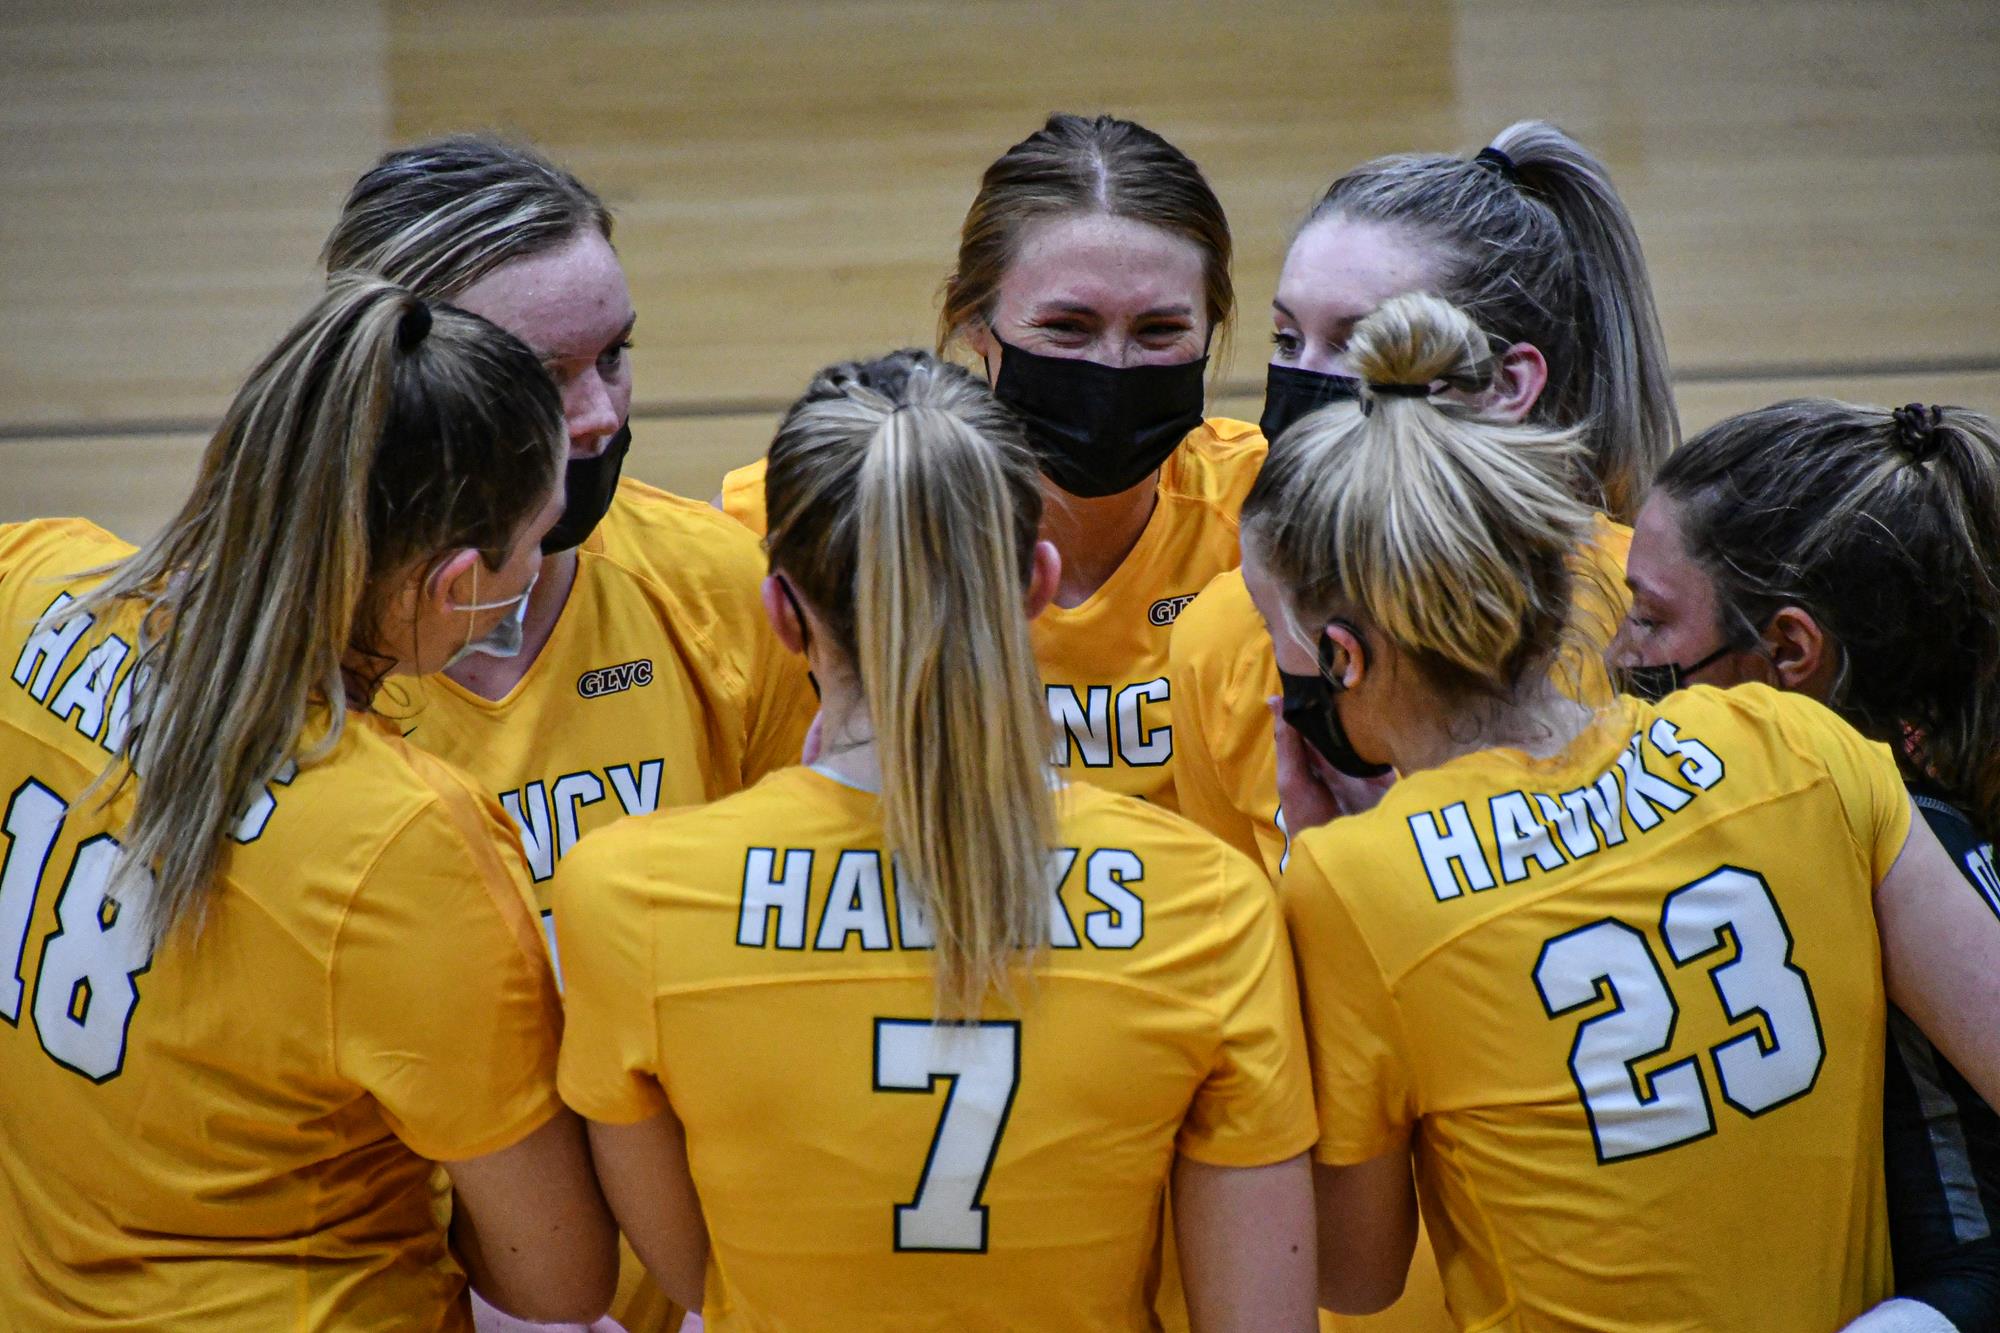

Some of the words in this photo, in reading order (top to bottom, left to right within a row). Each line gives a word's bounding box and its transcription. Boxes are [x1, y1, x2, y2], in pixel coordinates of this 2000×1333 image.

[577, 659, 653, 699] GLVC
[1407, 718, 1725, 903] HAWKS
[0, 776, 156, 1083] 18
[1531, 865, 1826, 1166] 23
[873, 1017, 1021, 1254] 7
